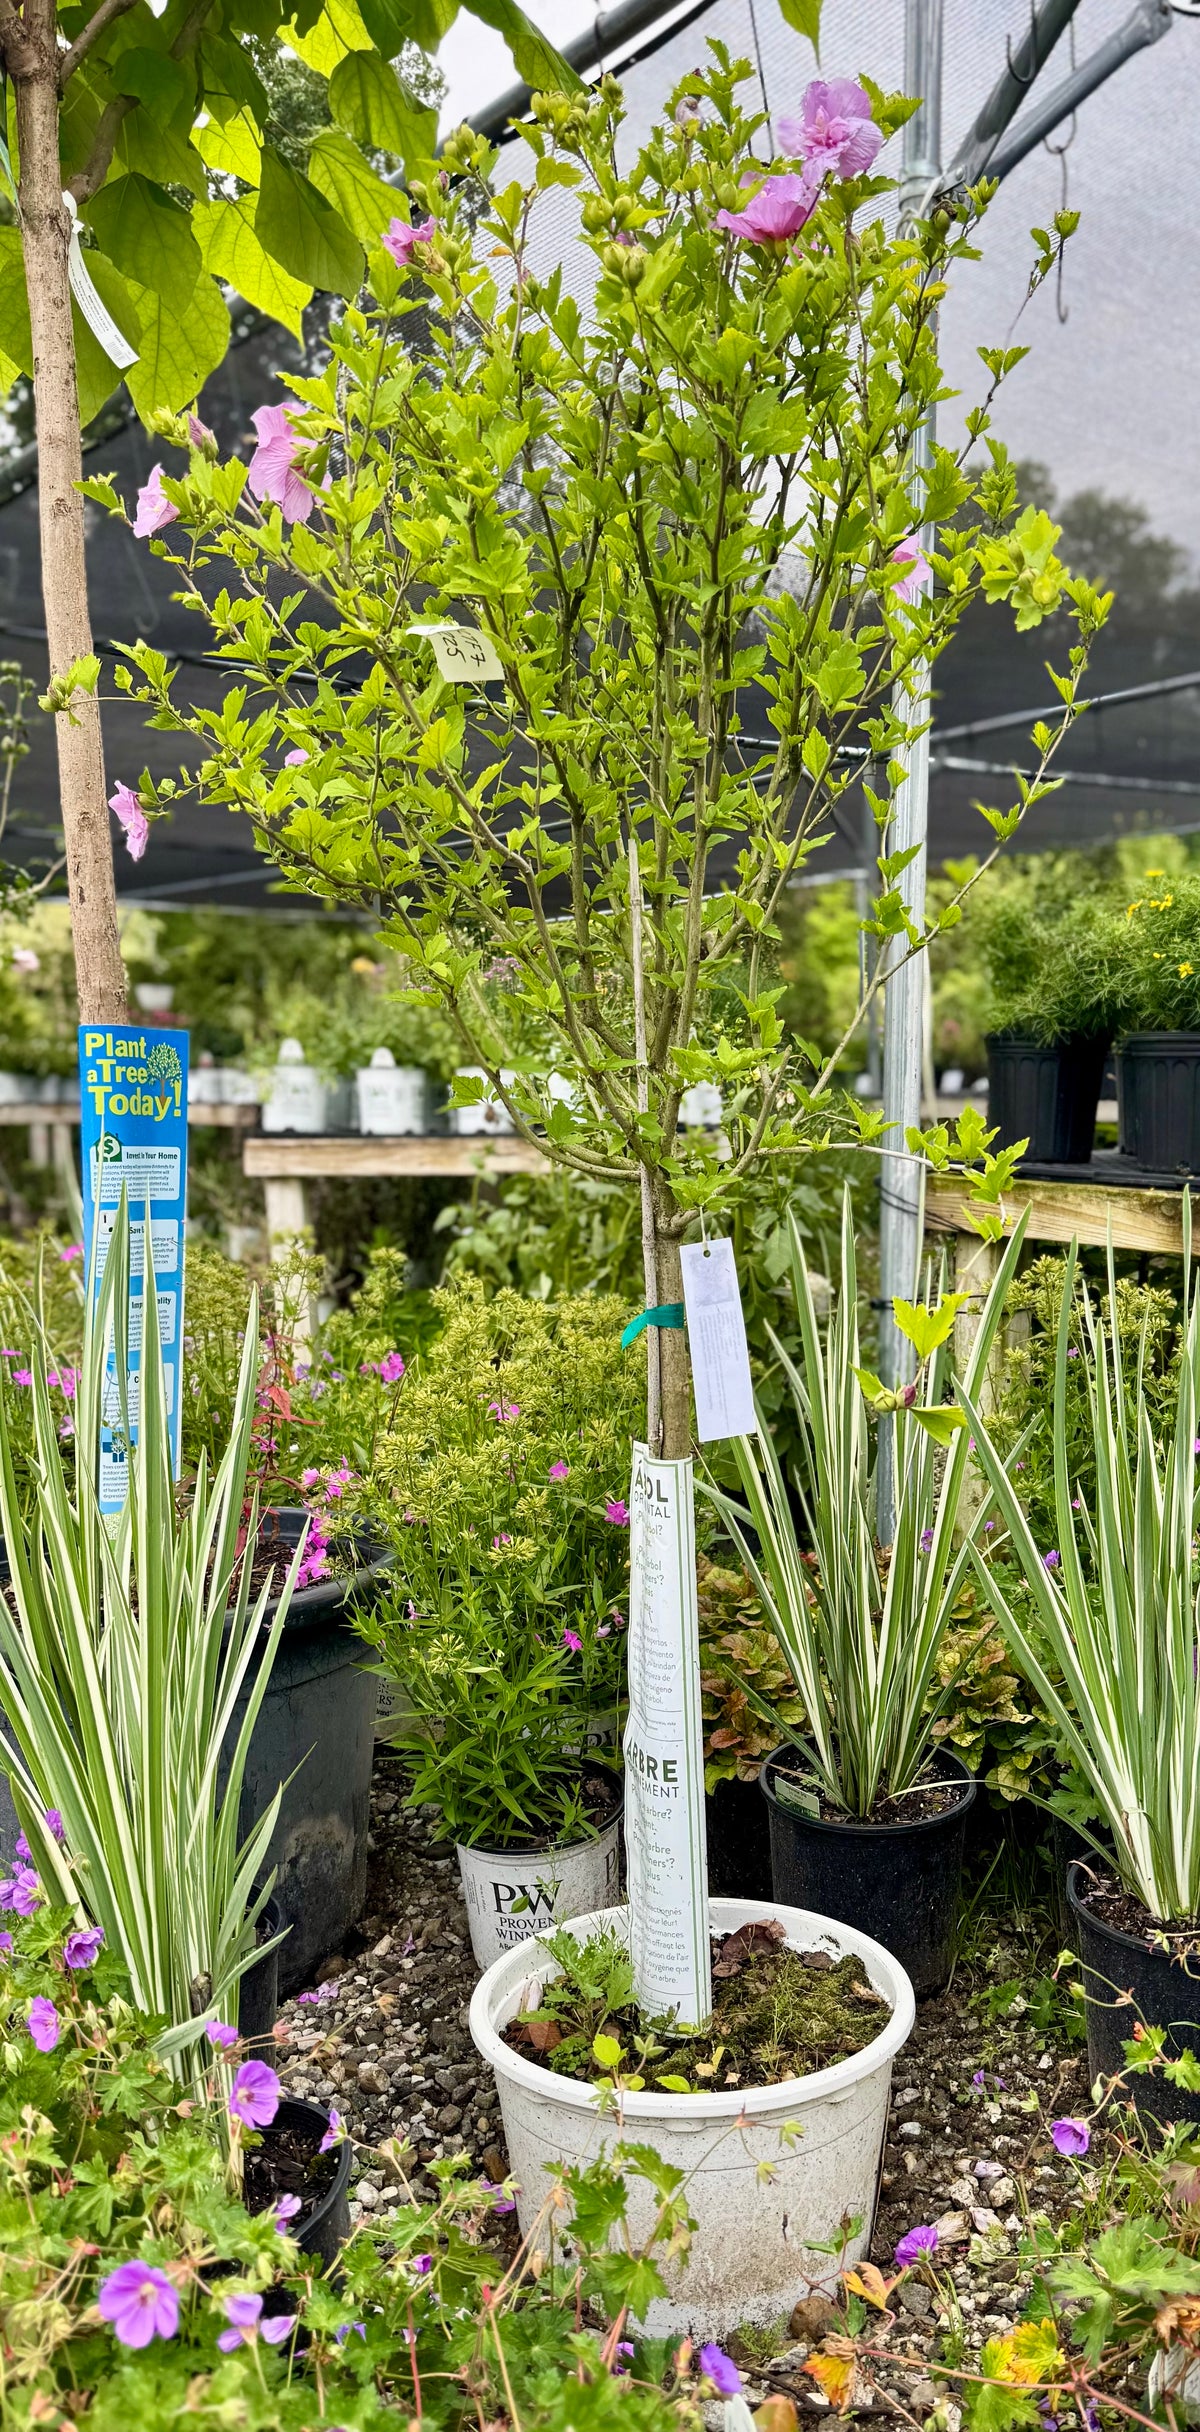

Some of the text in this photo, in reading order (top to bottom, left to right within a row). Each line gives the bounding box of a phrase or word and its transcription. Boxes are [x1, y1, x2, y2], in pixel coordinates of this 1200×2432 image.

[85, 1033, 147, 1059] Plant
[87, 1059, 148, 1084] a Tree
[88, 1080, 182, 1122] Today!
[158, 1152, 178, 1160] Home
[627, 1737, 678, 1782] ARBRE
[489, 1879, 564, 1915] PW
[496, 1928, 534, 1941] WINN
[499, 1916, 558, 1929] PROVEN
